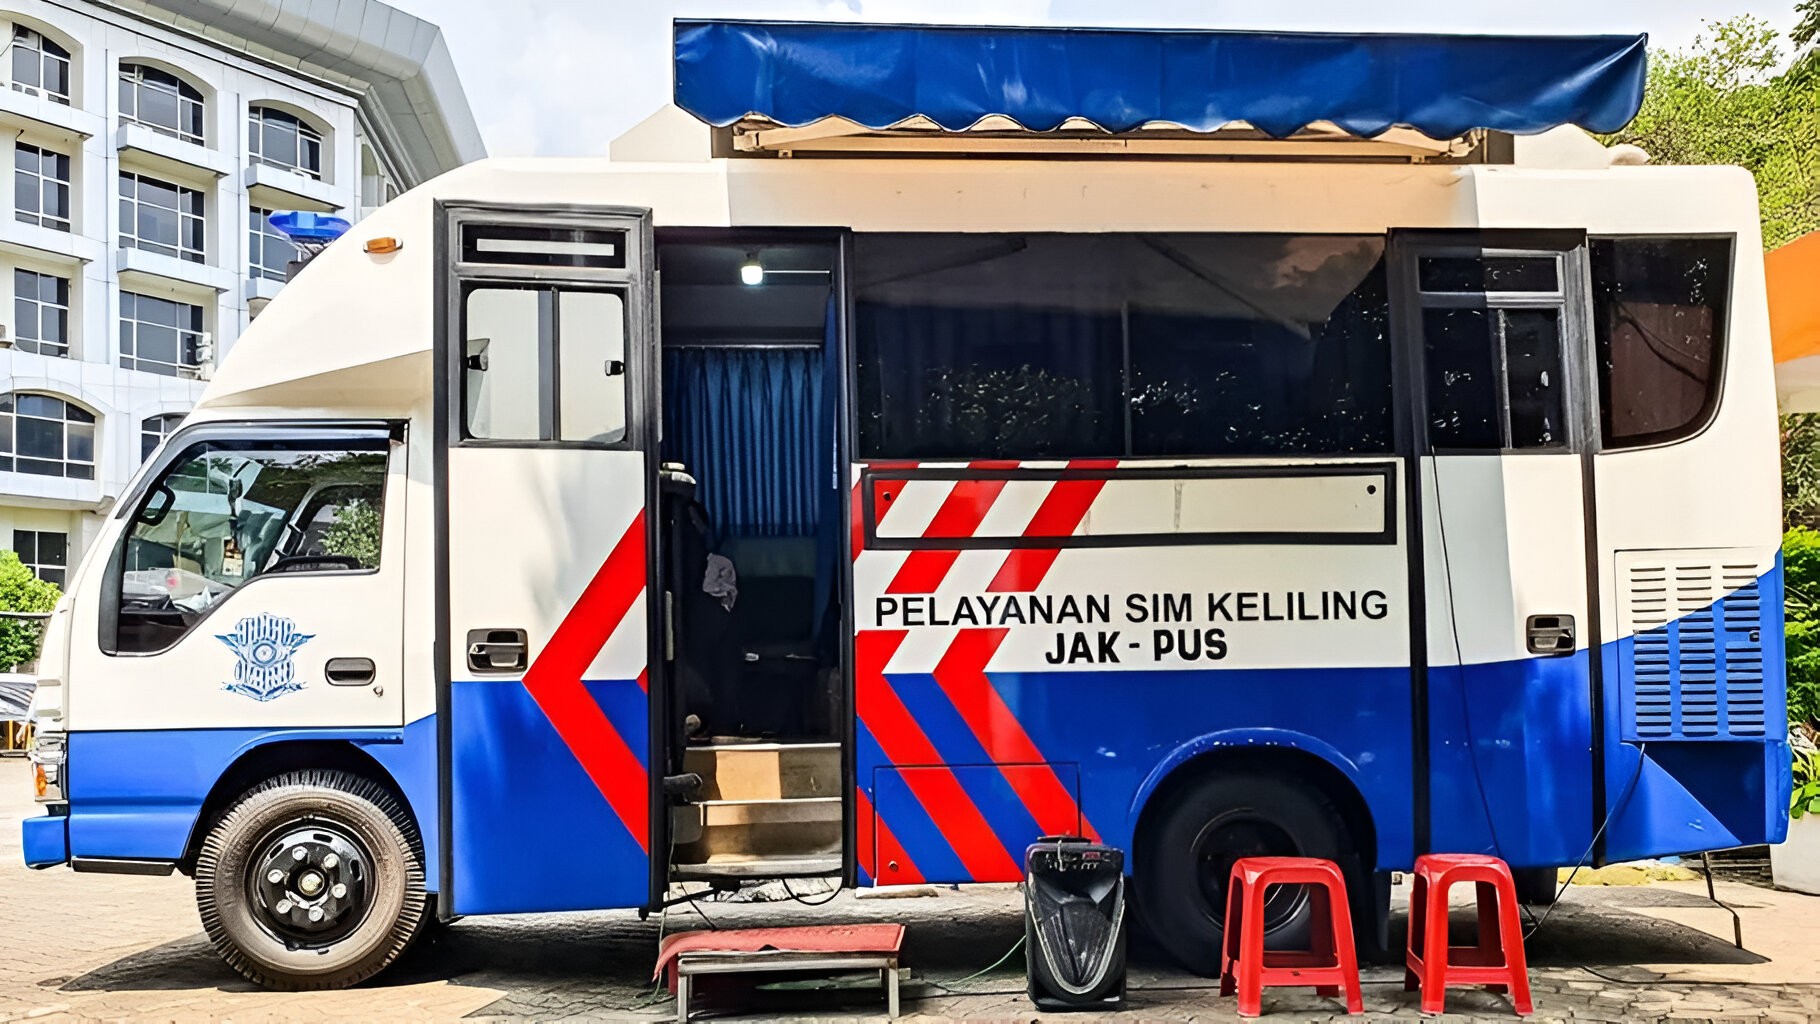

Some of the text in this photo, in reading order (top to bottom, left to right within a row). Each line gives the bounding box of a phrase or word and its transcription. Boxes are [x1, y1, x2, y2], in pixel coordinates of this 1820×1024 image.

[876, 589, 1388, 627] PELAYANAN SIM KELILING
[1045, 631, 1121, 665] JAK
[1153, 628, 1228, 662] PUS
